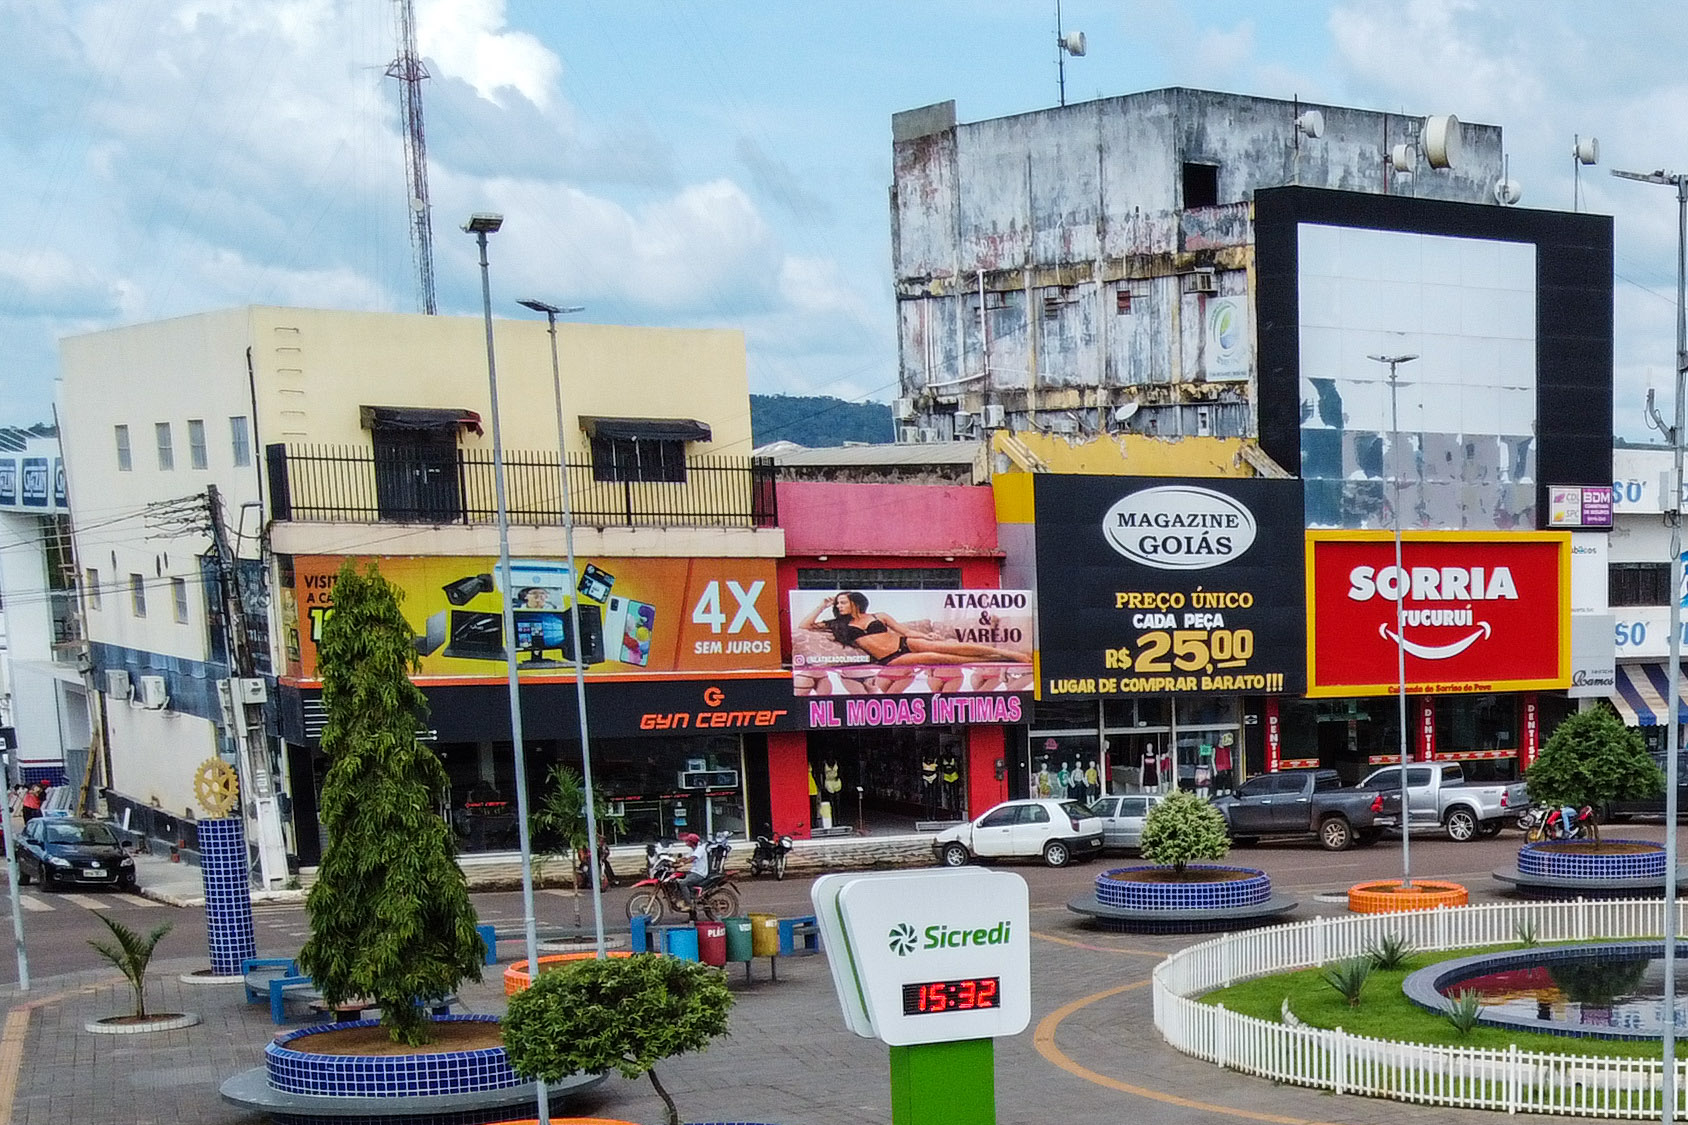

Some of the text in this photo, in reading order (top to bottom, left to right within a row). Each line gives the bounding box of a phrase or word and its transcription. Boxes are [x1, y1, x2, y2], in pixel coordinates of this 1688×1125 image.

[1583, 491, 1611, 503] BDM
[1117, 512, 1240, 529] MAGAZINE
[1139, 530, 1233, 556] GOIÁS
[1347, 565, 1519, 601] SORRIA
[692, 580, 771, 634] 4X
[944, 593, 1027, 609] ATACADO
[1115, 585, 1254, 612] PREÇO ÚNICO
[978, 611, 992, 626] &
[1132, 613, 1225, 630] CADA PEÇA
[1400, 604, 1473, 627] TUCURUÍ
[694, 640, 771, 654] SEM JUROS
[1105, 647, 1133, 670] R$
[1050, 678, 1096, 694] LUGAR
[1099, 678, 1118, 693] DE
[1120, 676, 1198, 693] COMPRAR
[809, 693, 1022, 727] NL MODAS ÍNTIMAS
[1269, 716, 1279, 772] DENTIS
[1424, 708, 1433, 762] DENTIS
[923, 920, 1012, 950] Sicredi
[918, 979, 997, 1013] 15:32
